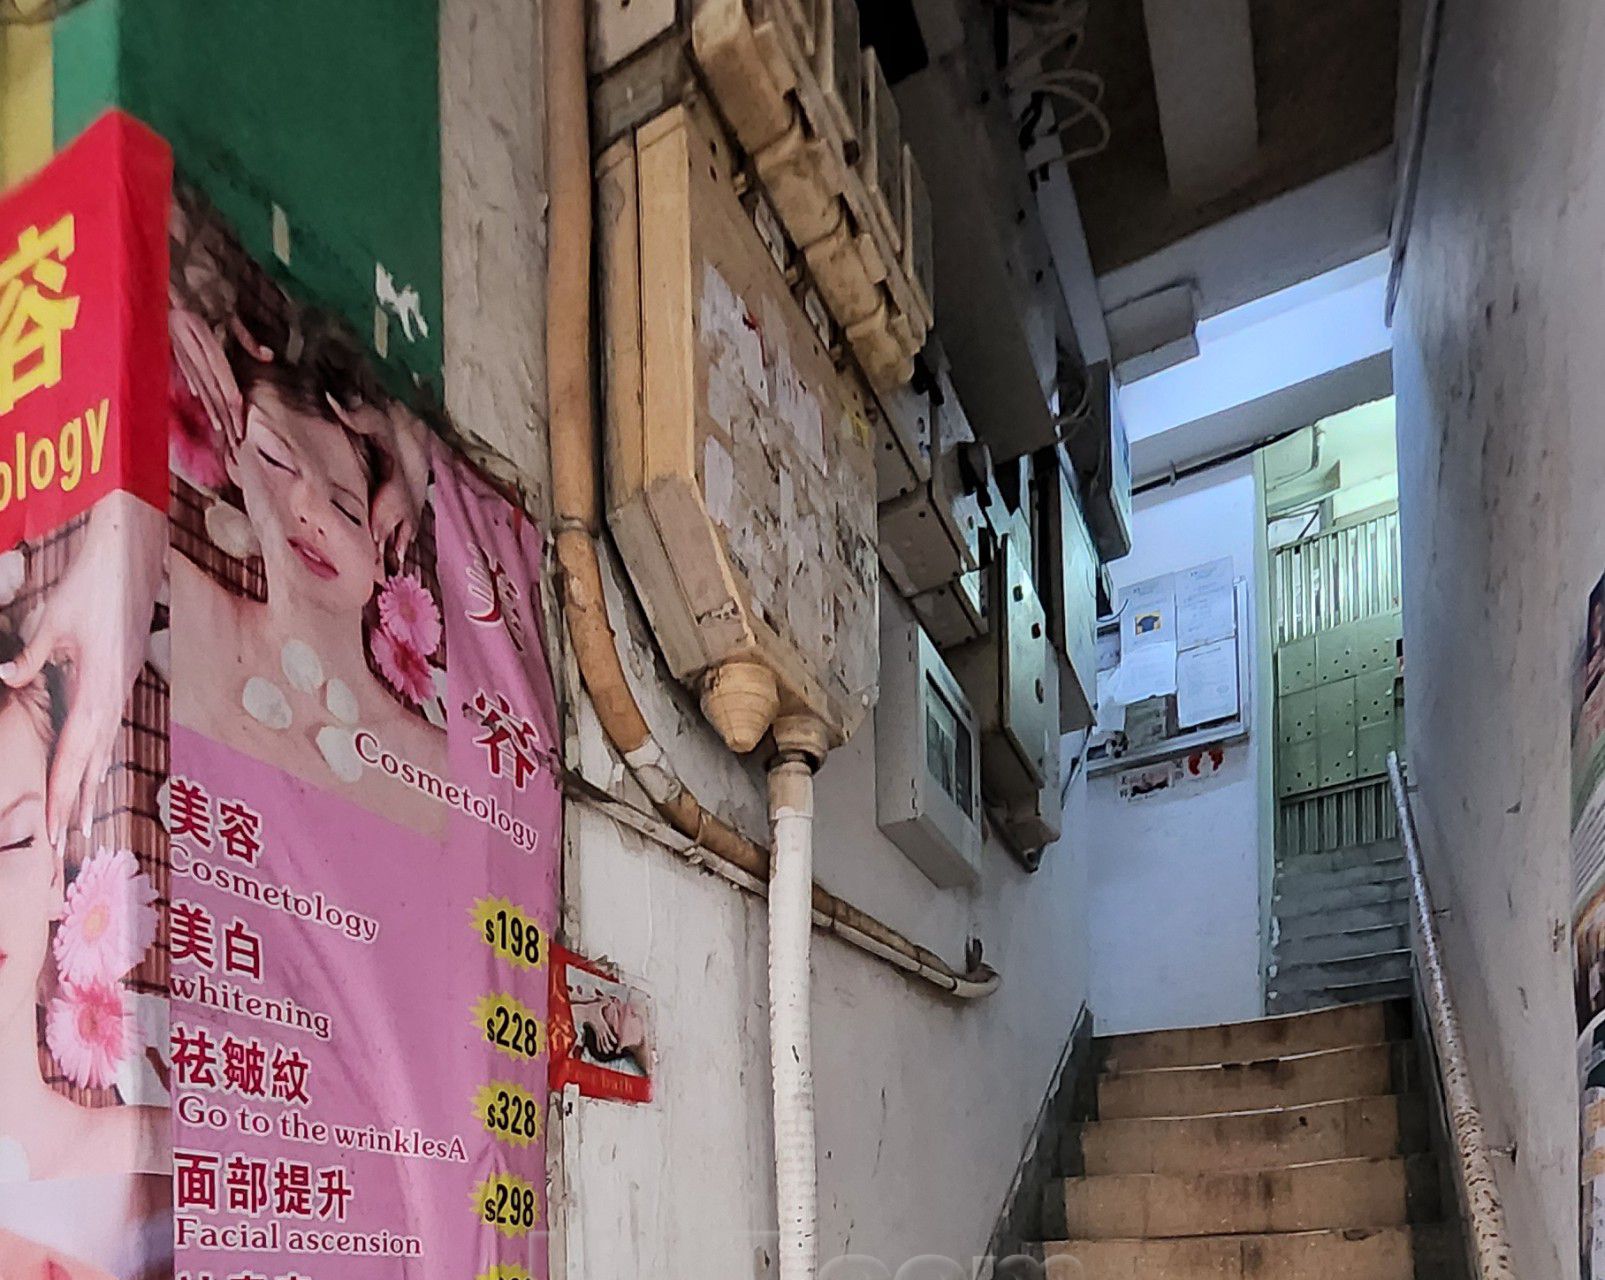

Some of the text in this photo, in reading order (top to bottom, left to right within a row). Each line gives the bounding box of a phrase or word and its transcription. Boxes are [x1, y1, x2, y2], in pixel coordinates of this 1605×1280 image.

[168, 779, 261, 865] 美容
[355, 731, 538, 850] Cosmetology
[169, 845, 378, 940] Cosmetology
[169, 903, 262, 981] 美白
[170, 974, 330, 1038] whitening
[486, 1006, 538, 1058] $228
[178, 1096, 467, 1162] Go to the wrinklesA
[487, 1091, 536, 1138] $328
[174, 1152, 352, 1221] 面部提升
[176, 1217, 422, 1256] Facial ascension
